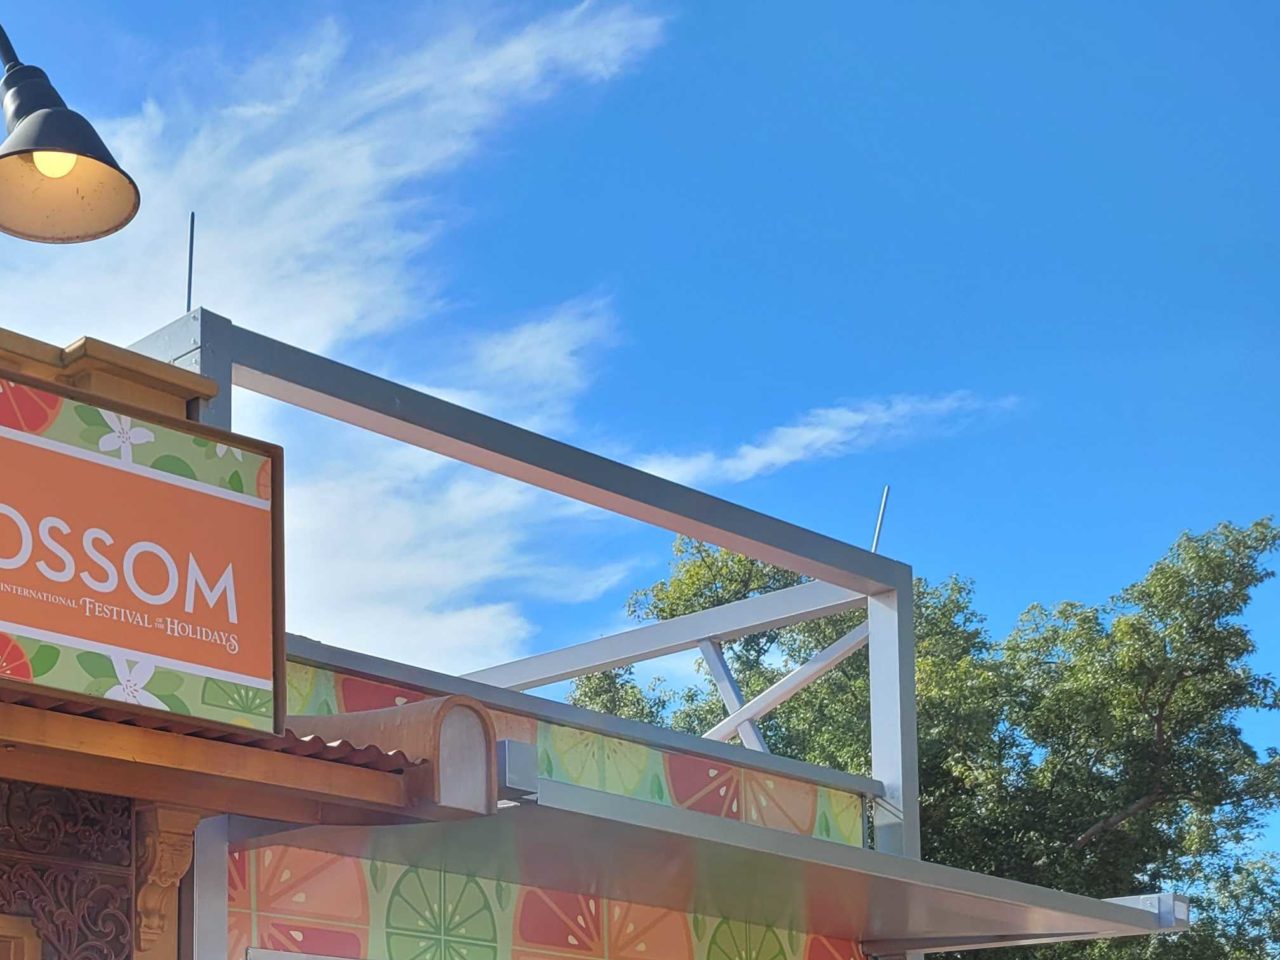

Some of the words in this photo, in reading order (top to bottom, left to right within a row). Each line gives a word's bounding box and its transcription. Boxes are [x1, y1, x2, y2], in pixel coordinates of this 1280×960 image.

[0, 582, 78, 608] INTERNATIONAL
[80, 597, 152, 628] FESTIVAL
[166, 617, 239, 654] HOLIDAYS
